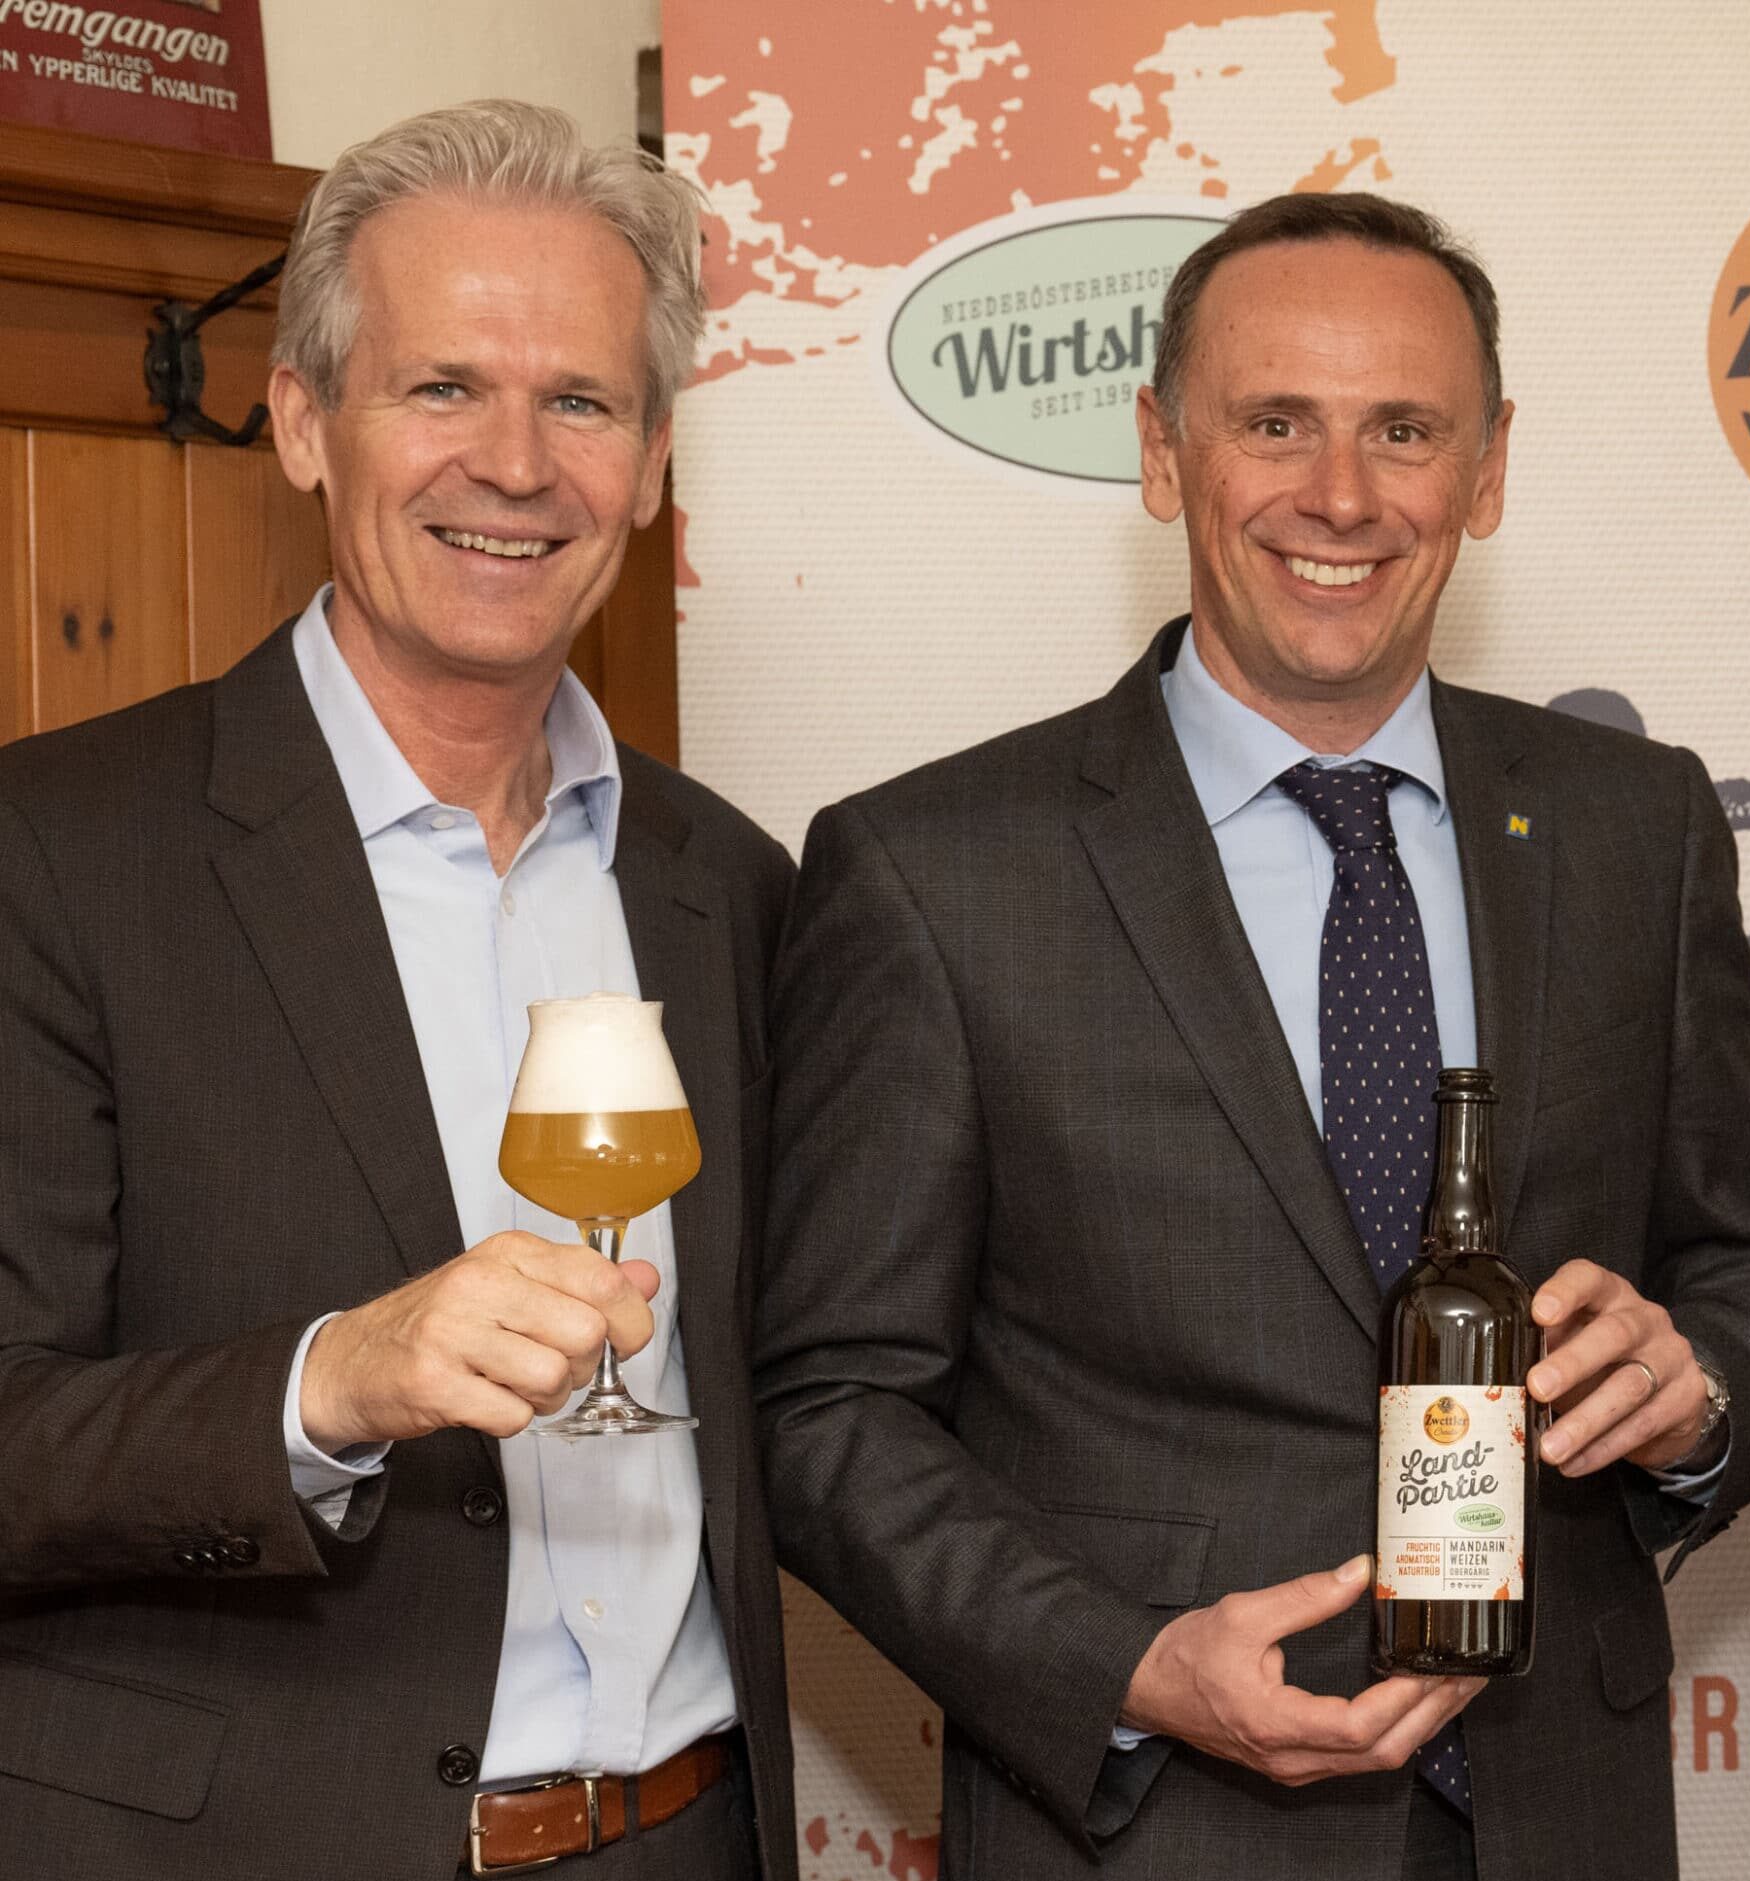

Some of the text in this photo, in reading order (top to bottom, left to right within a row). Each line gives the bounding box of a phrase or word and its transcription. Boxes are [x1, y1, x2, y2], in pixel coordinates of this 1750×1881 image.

[82, 47, 154, 74] SKYLDES
[28, 53, 144, 93] YPPERLIGE
[151, 75, 238, 111] KVALITET
[1032, 391, 1084, 419] SEIT
[1400, 1441, 1495, 1485] Land-
[1406, 1542, 1441, 1552] FRUCHTIG
[1450, 1540, 1505, 1552] MANDARIN
[1396, 1554, 1441, 1564] AROMATISCH
[1450, 1554, 1488, 1566] WEIZEN
